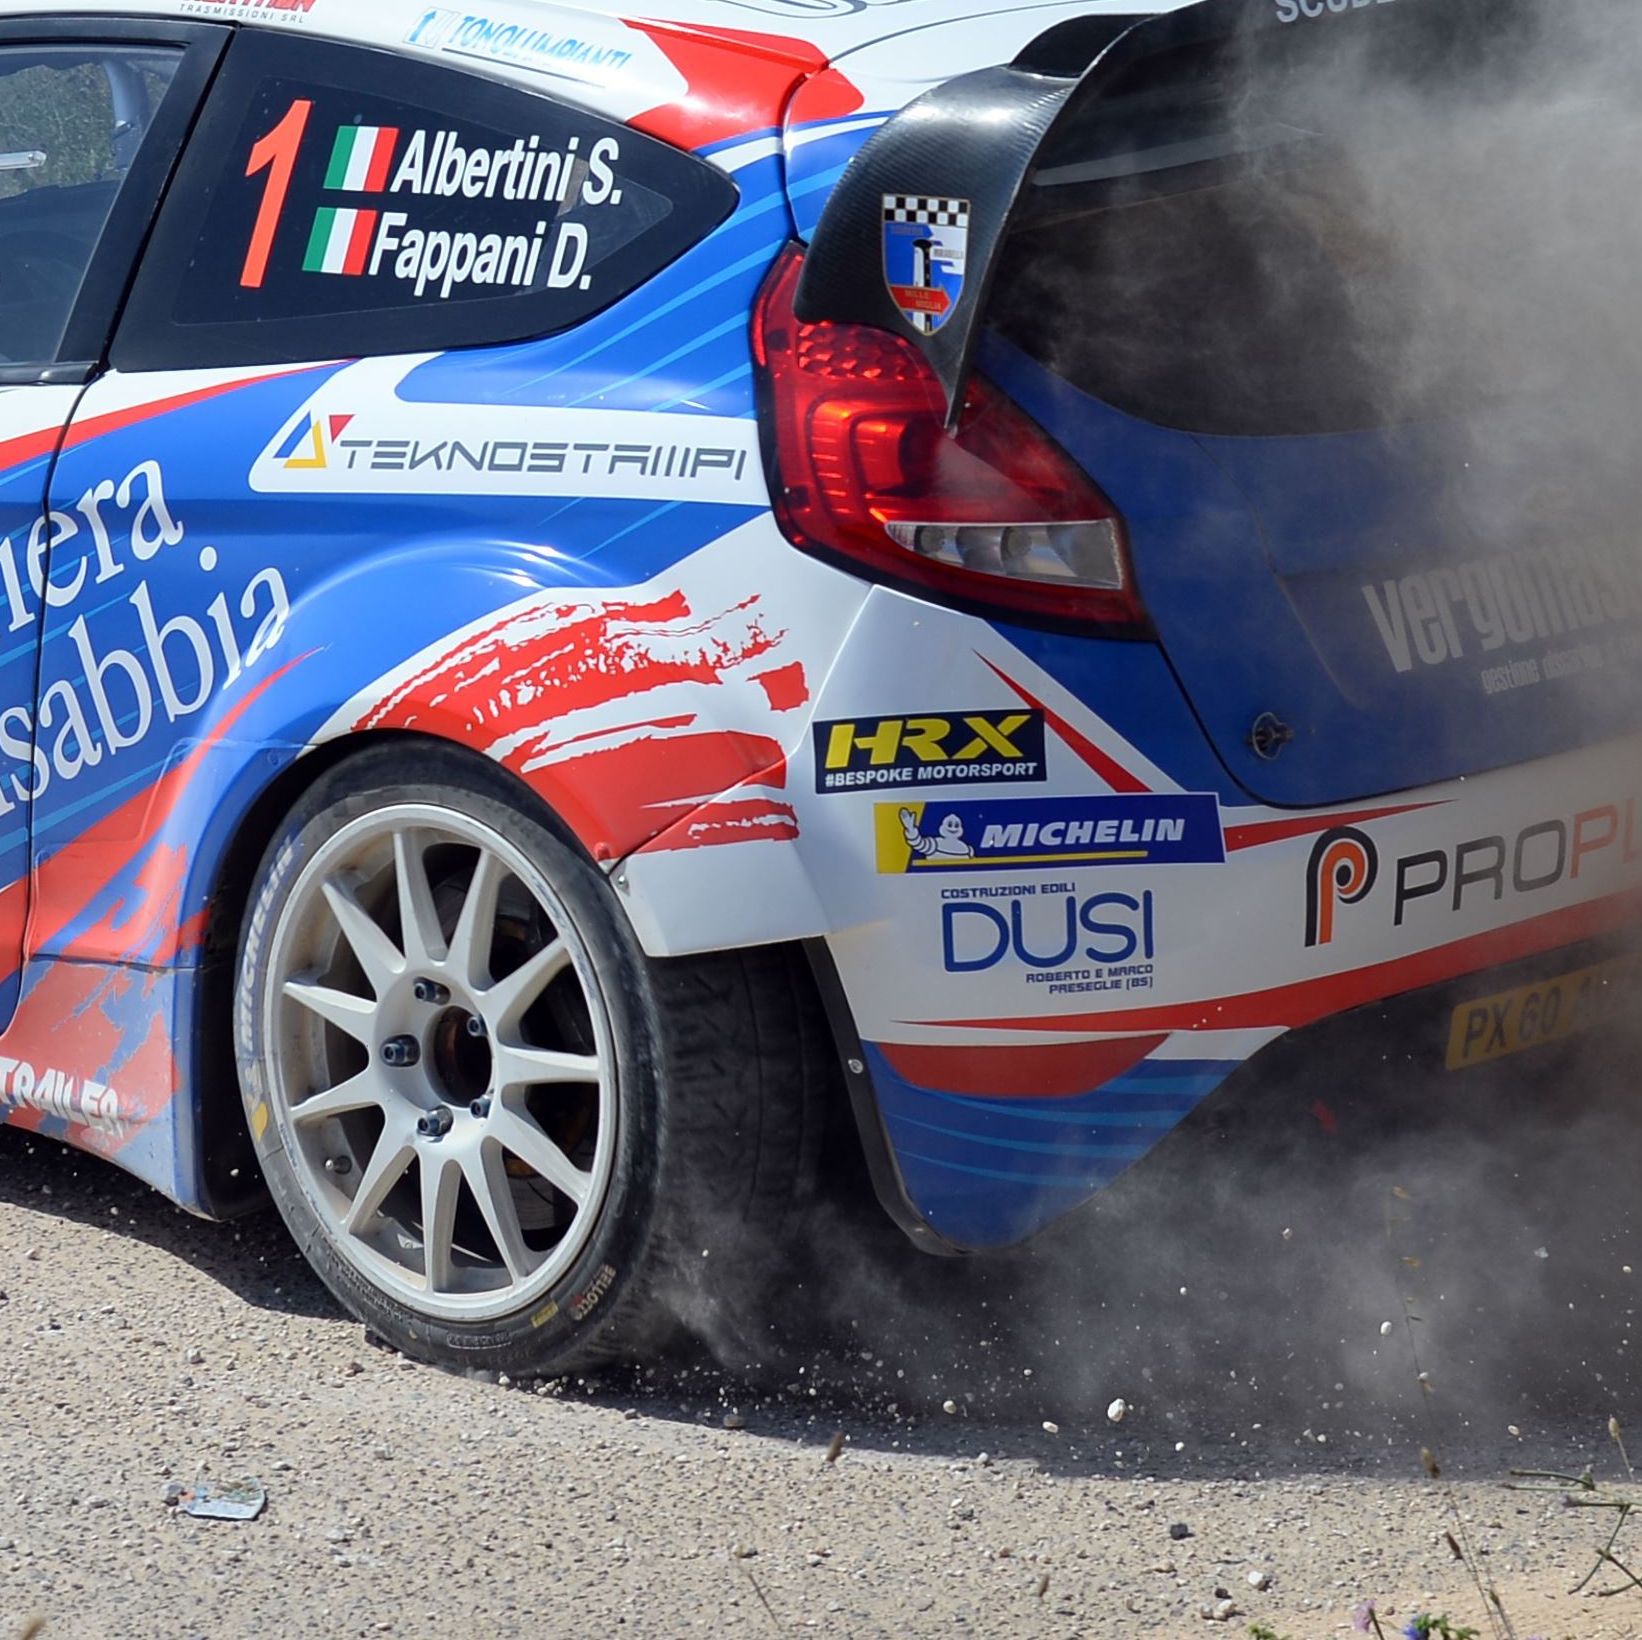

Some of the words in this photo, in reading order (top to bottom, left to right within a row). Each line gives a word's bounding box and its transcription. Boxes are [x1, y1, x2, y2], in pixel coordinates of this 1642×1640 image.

[179, 3, 274, 20] TRASMISSIONI
[278, 13, 305, 24] SRL
[390, 130, 580, 205] Albertini
[582, 138, 622, 207] S.
[240, 99, 312, 289] 1
[367, 211, 544, 297] Fappani
[547, 223, 591, 291] D.
[825, 714, 1032, 769] HRX
[825, 766, 913, 788] #BESPOKE
[917, 762, 1038, 781] MOTORSPORT
[980, 818, 1186, 849] MICHELIN
[941, 884, 1036, 899] COSTRUZIONI
[1040, 882, 1075, 895] EDILI
[942, 890, 1154, 972] DUSI
[1025, 970, 1091, 983] ROBERTO
[1095, 968, 1103, 979] E
[1107, 964, 1154, 978] MARCO
[1049, 979, 1123, 994] PRESEGLIE
[1461, 998, 1513, 1058] PX
[1518, 985, 1563, 1044] 60
